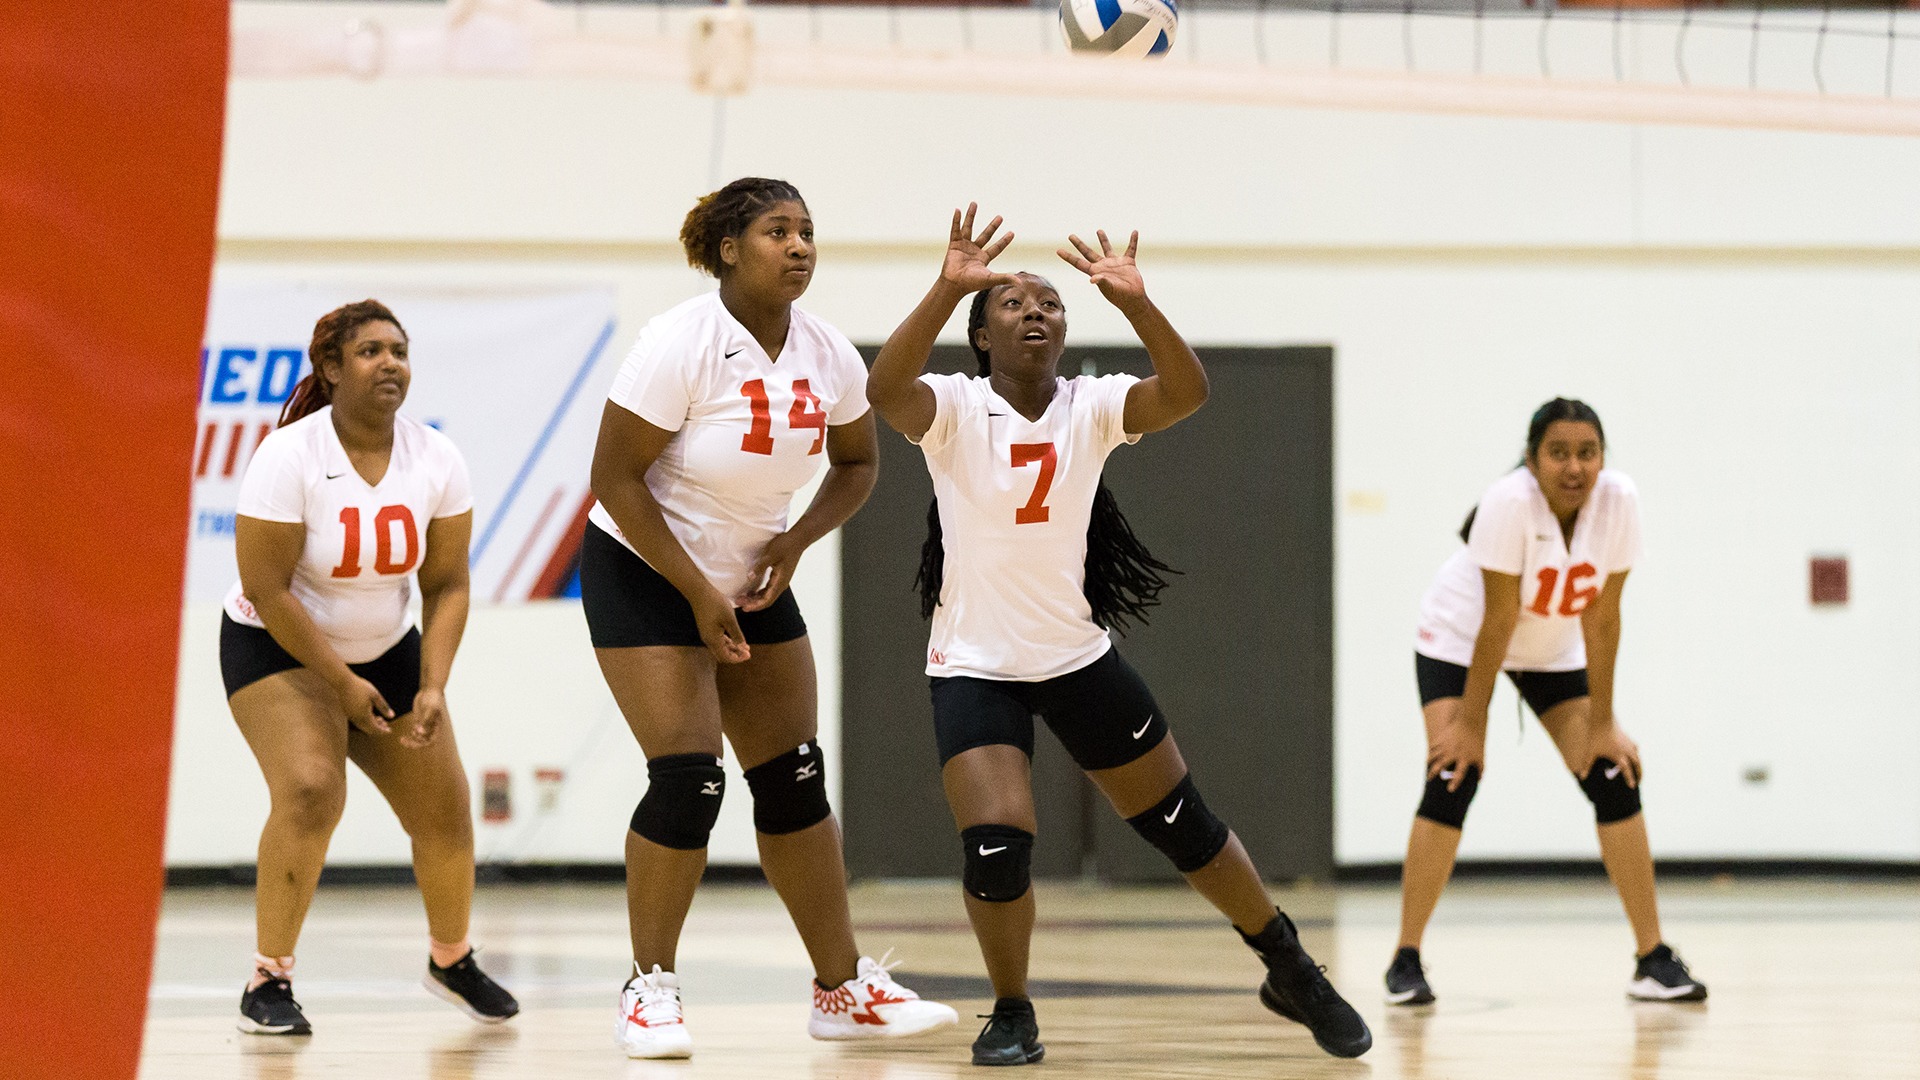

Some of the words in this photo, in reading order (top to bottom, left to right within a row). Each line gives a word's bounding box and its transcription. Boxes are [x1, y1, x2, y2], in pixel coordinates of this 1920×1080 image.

[199, 347, 303, 405] ED
[740, 378, 827, 456] 14
[1010, 442, 1057, 525] 7
[331, 504, 419, 578] 10
[1527, 562, 1597, 617] 16
